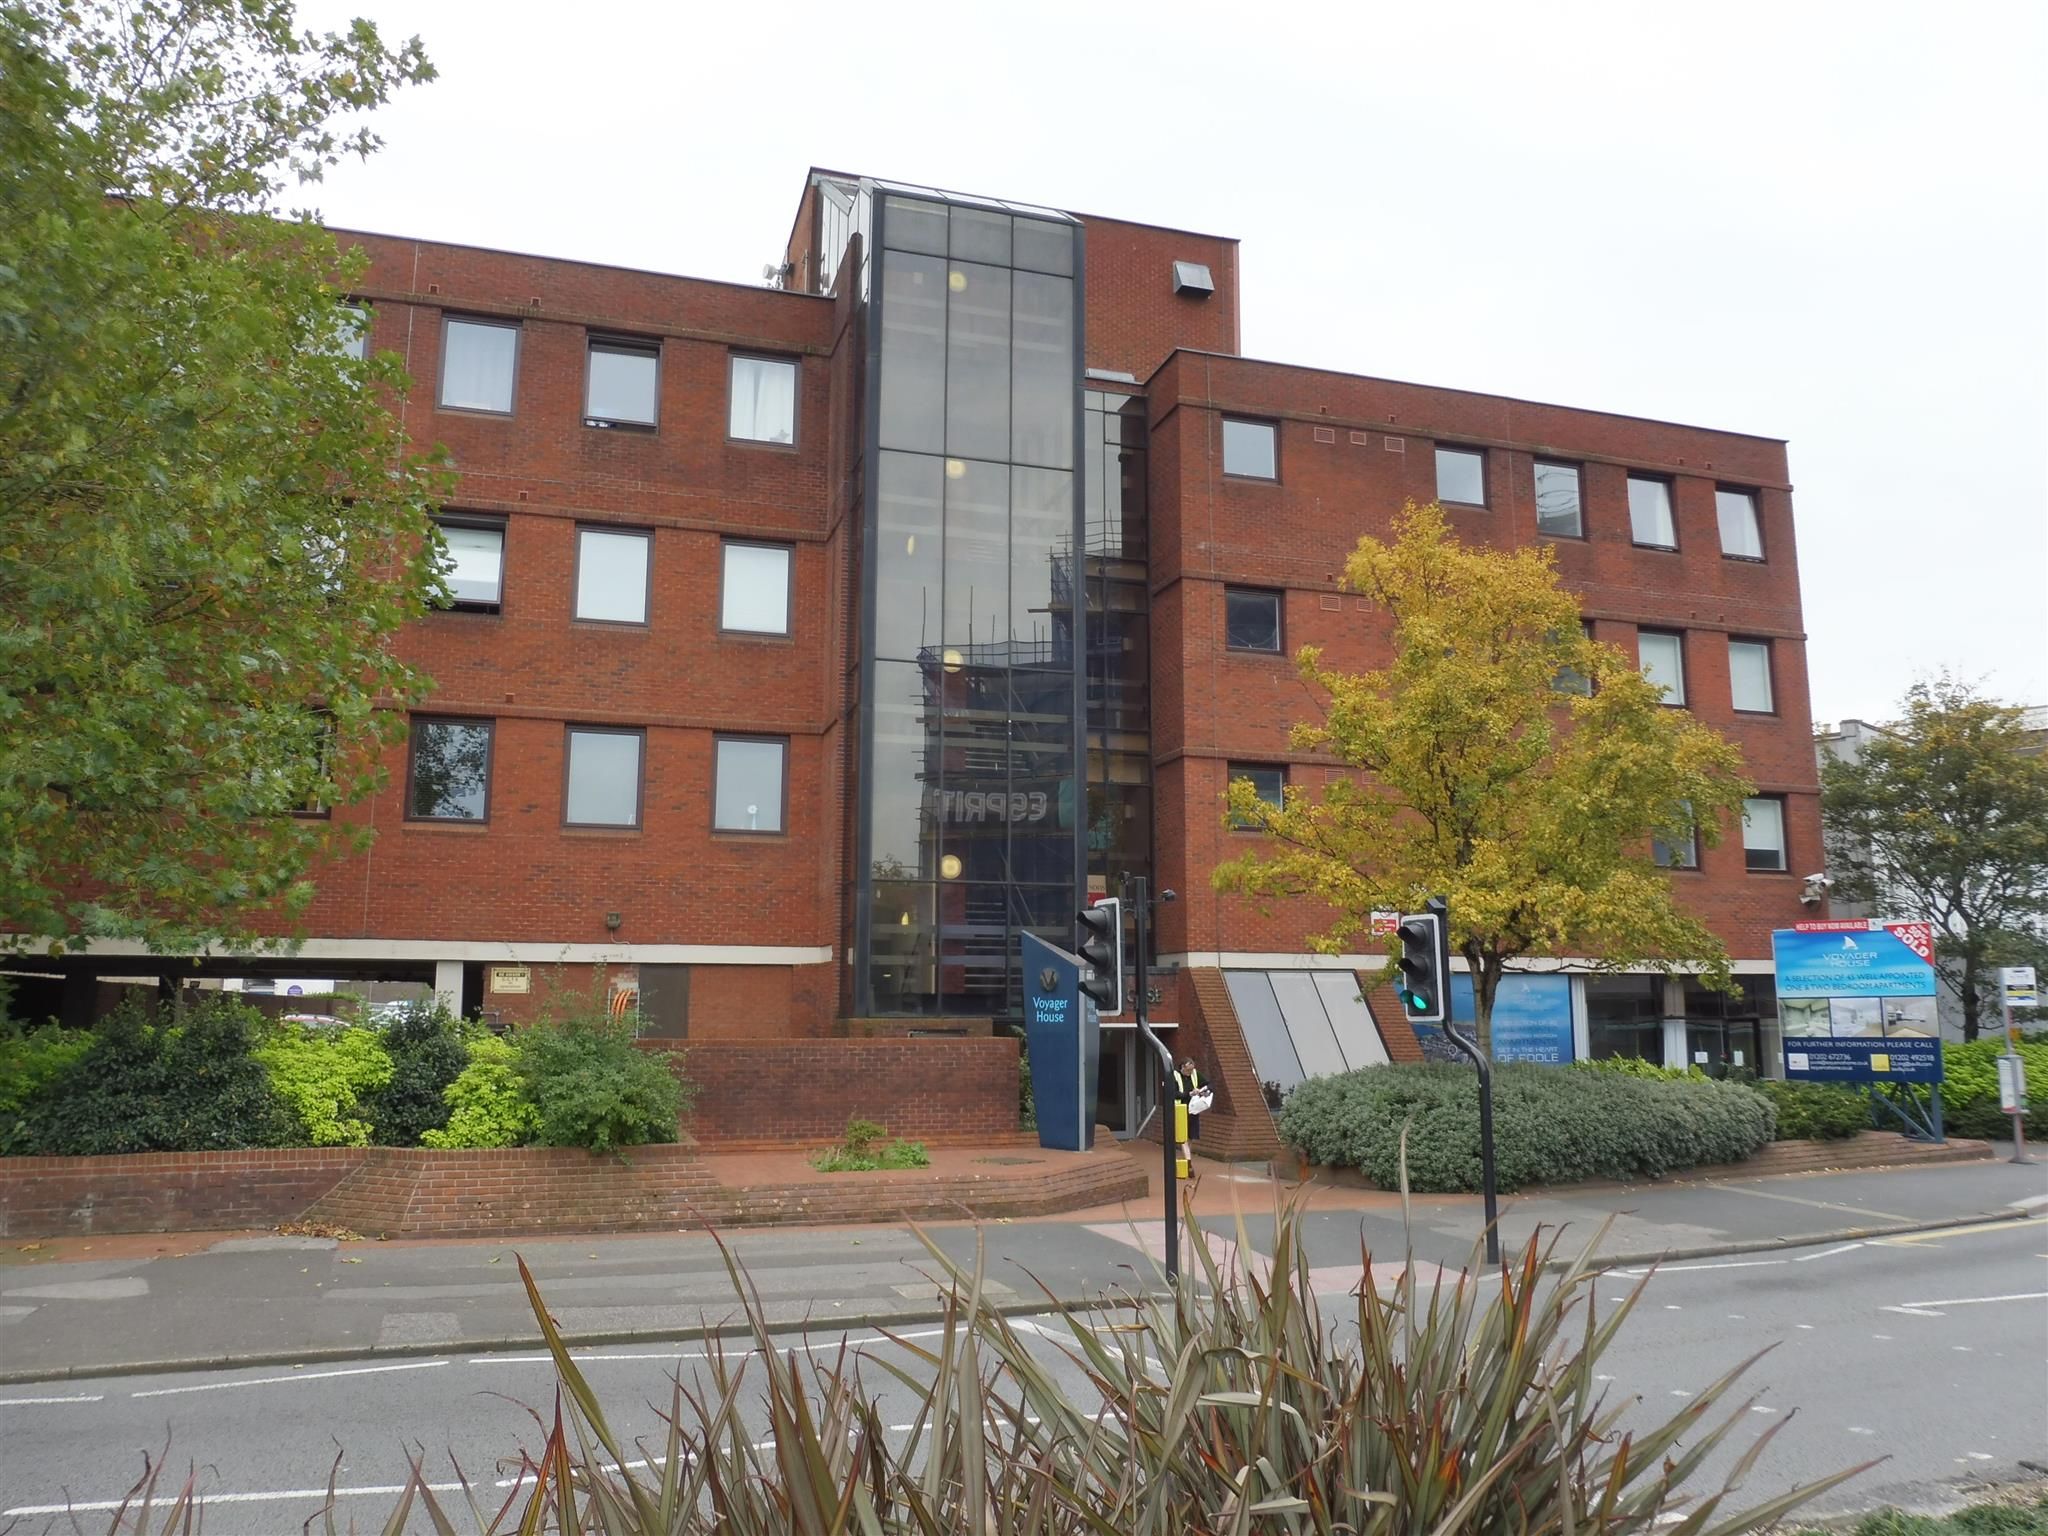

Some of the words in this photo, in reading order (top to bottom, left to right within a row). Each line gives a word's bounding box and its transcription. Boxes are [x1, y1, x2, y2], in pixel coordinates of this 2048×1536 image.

[1893, 926, 1930, 957] SOLD
[1823, 952, 1878, 960] VOYAGER
[1832, 960, 1870, 968] HOUSE
[1792, 974, 1833, 982] SELECTION
[1856, 973, 1879, 981] WELL
[1879, 971, 1926, 980] APPOINTED
[1785, 984, 1803, 992] ONE
[1810, 983, 1831, 991] TWO
[1832, 982, 1872, 991] BEDROOM
[1872, 980, 1927, 990] APARTMENTS
[1032, 996, 1068, 1011] Voyager
[1036, 1010, 1065, 1023] House
[1497, 1054, 1514, 1063] OF
